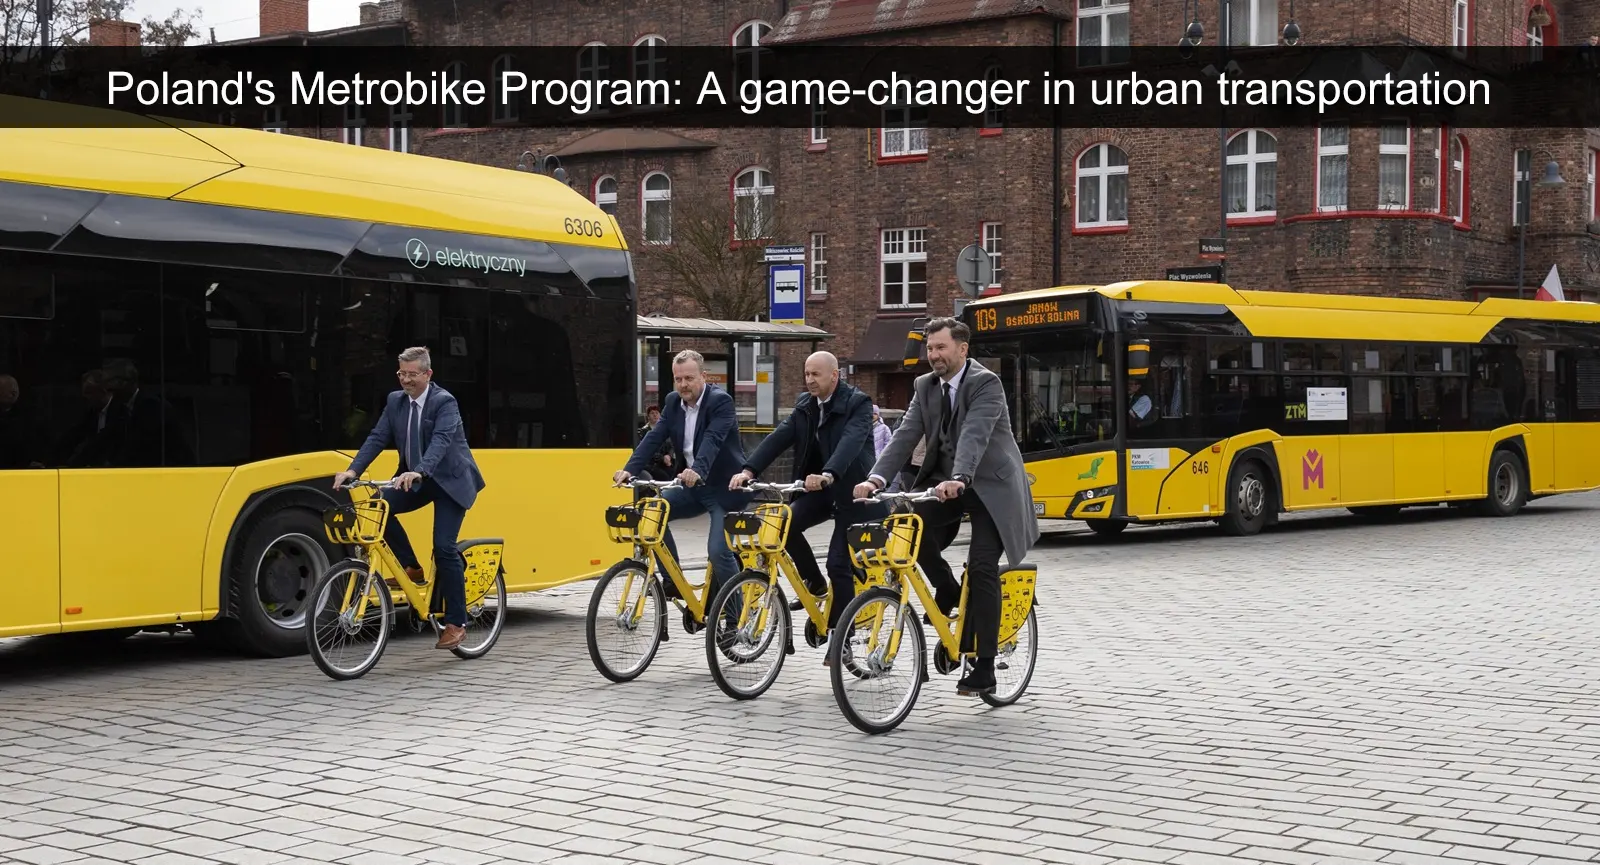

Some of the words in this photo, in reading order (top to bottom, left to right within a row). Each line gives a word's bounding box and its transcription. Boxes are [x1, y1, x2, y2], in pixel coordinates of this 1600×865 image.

[564, 217, 603, 238] 6306
[435, 247, 526, 277] elektryczny
[974, 308, 997, 331] 109
[1047, 310, 1080, 323] BOLINA
[1285, 403, 1307, 419] ZTM
[1192, 460, 1209, 475] 646
